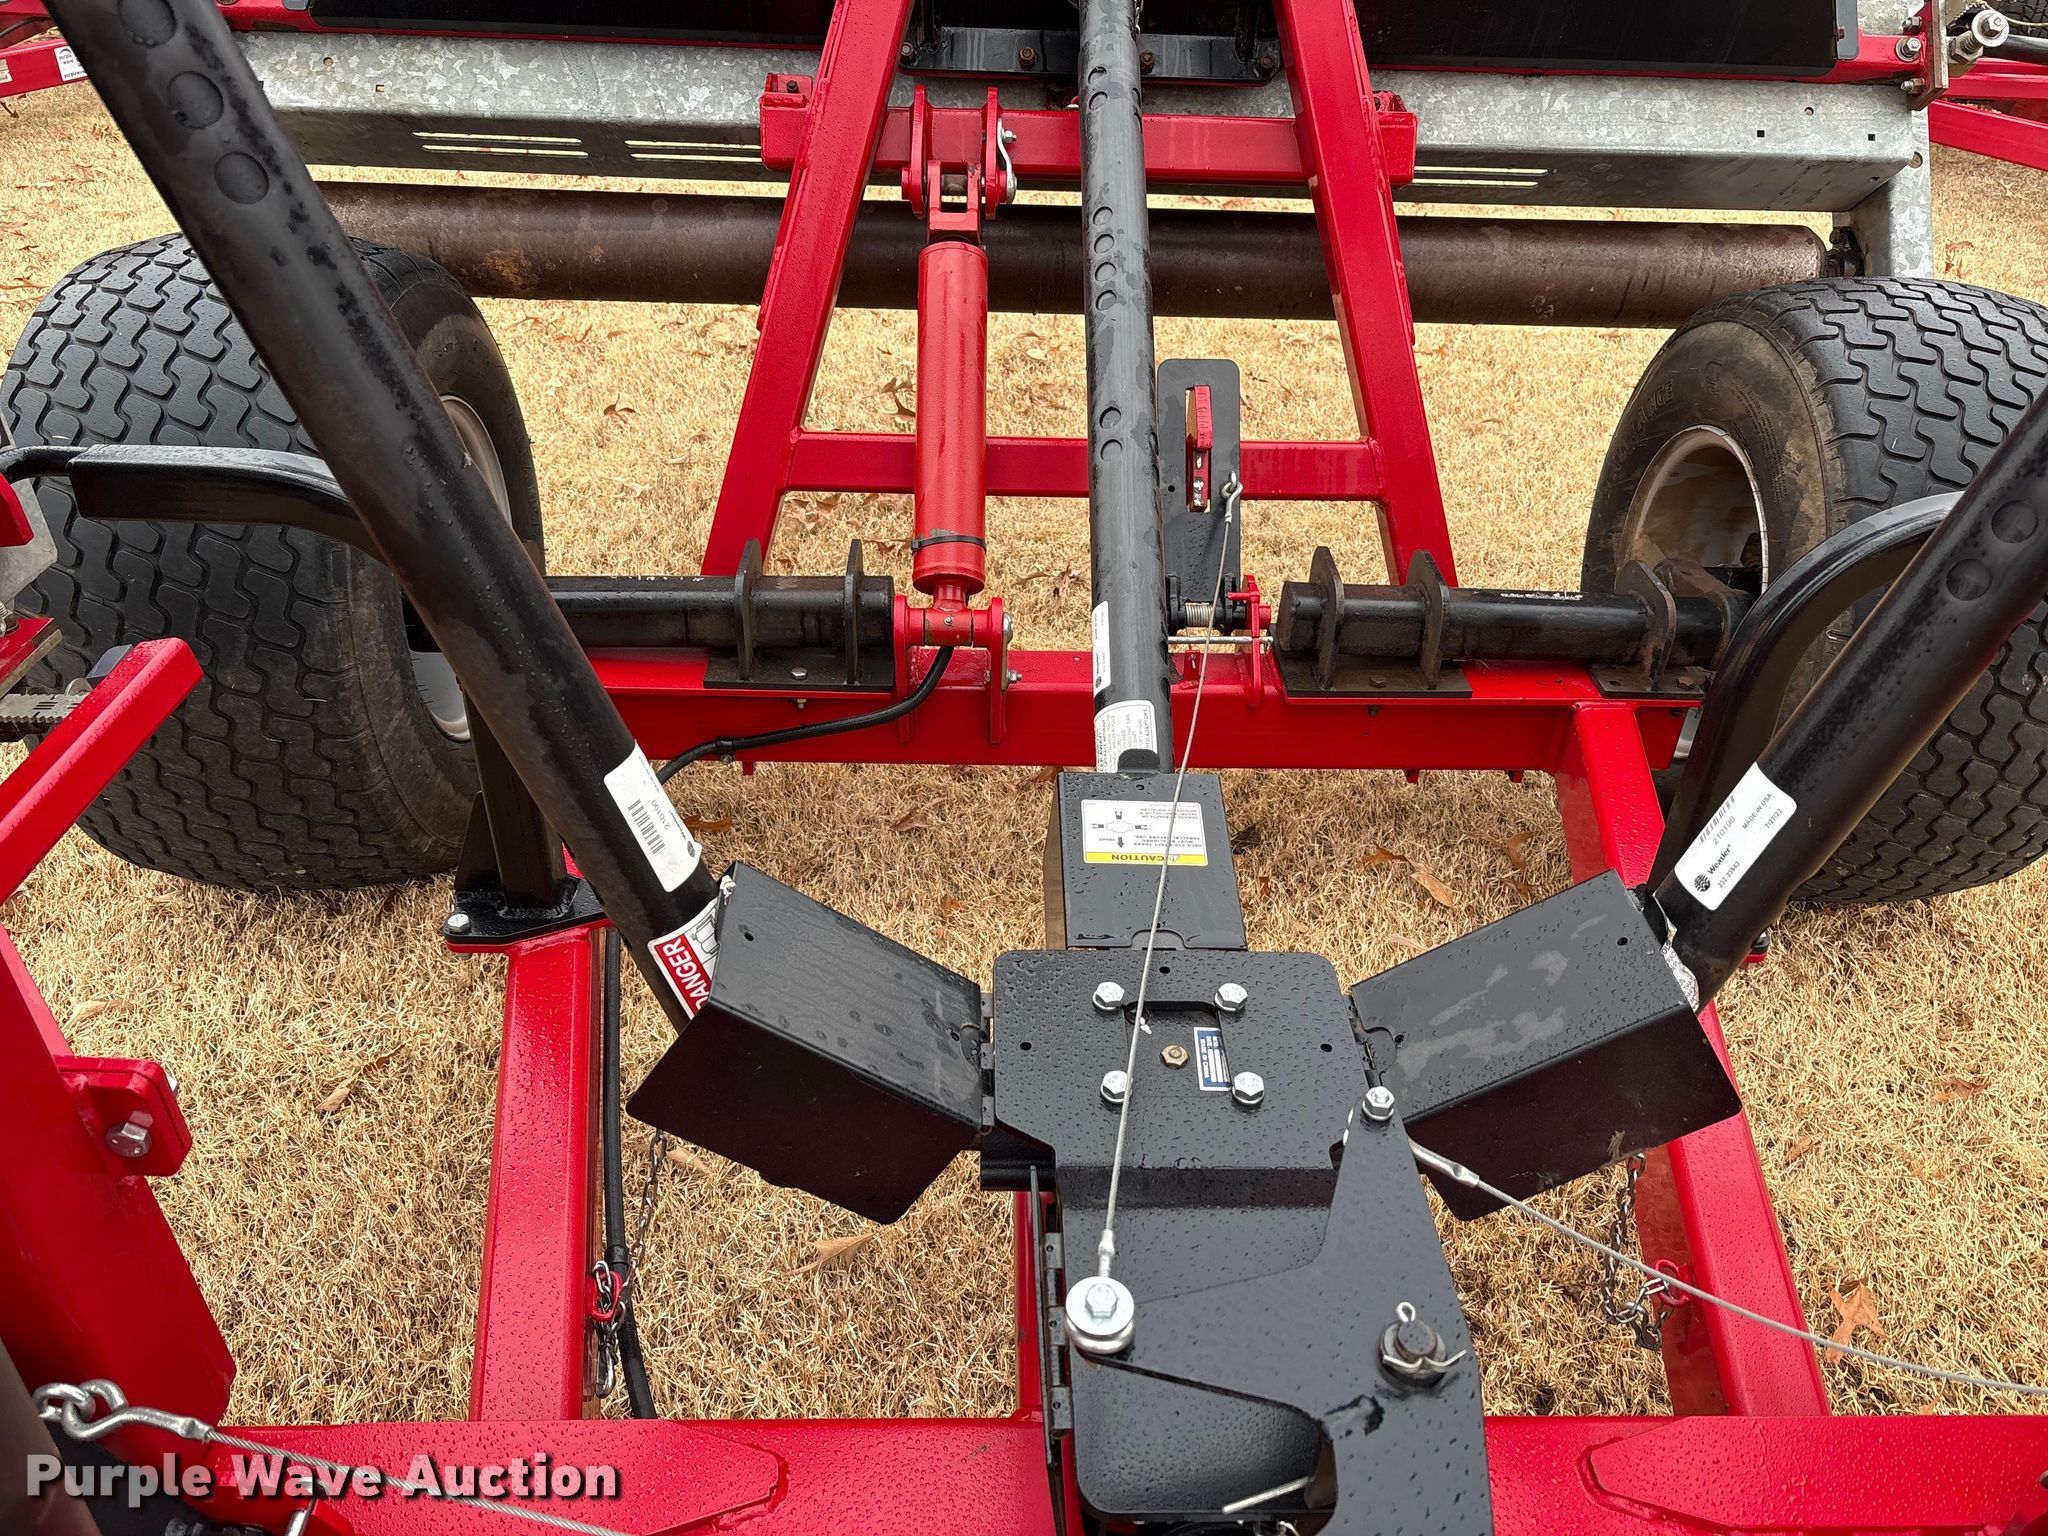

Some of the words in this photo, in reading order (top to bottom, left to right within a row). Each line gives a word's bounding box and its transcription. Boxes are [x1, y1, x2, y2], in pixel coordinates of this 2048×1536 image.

[1742, 814, 1757, 830] MADE
[1756, 806, 1763, 814] IN
[1760, 793, 1772, 807] USA
[1712, 815, 1736, 845] 210190
